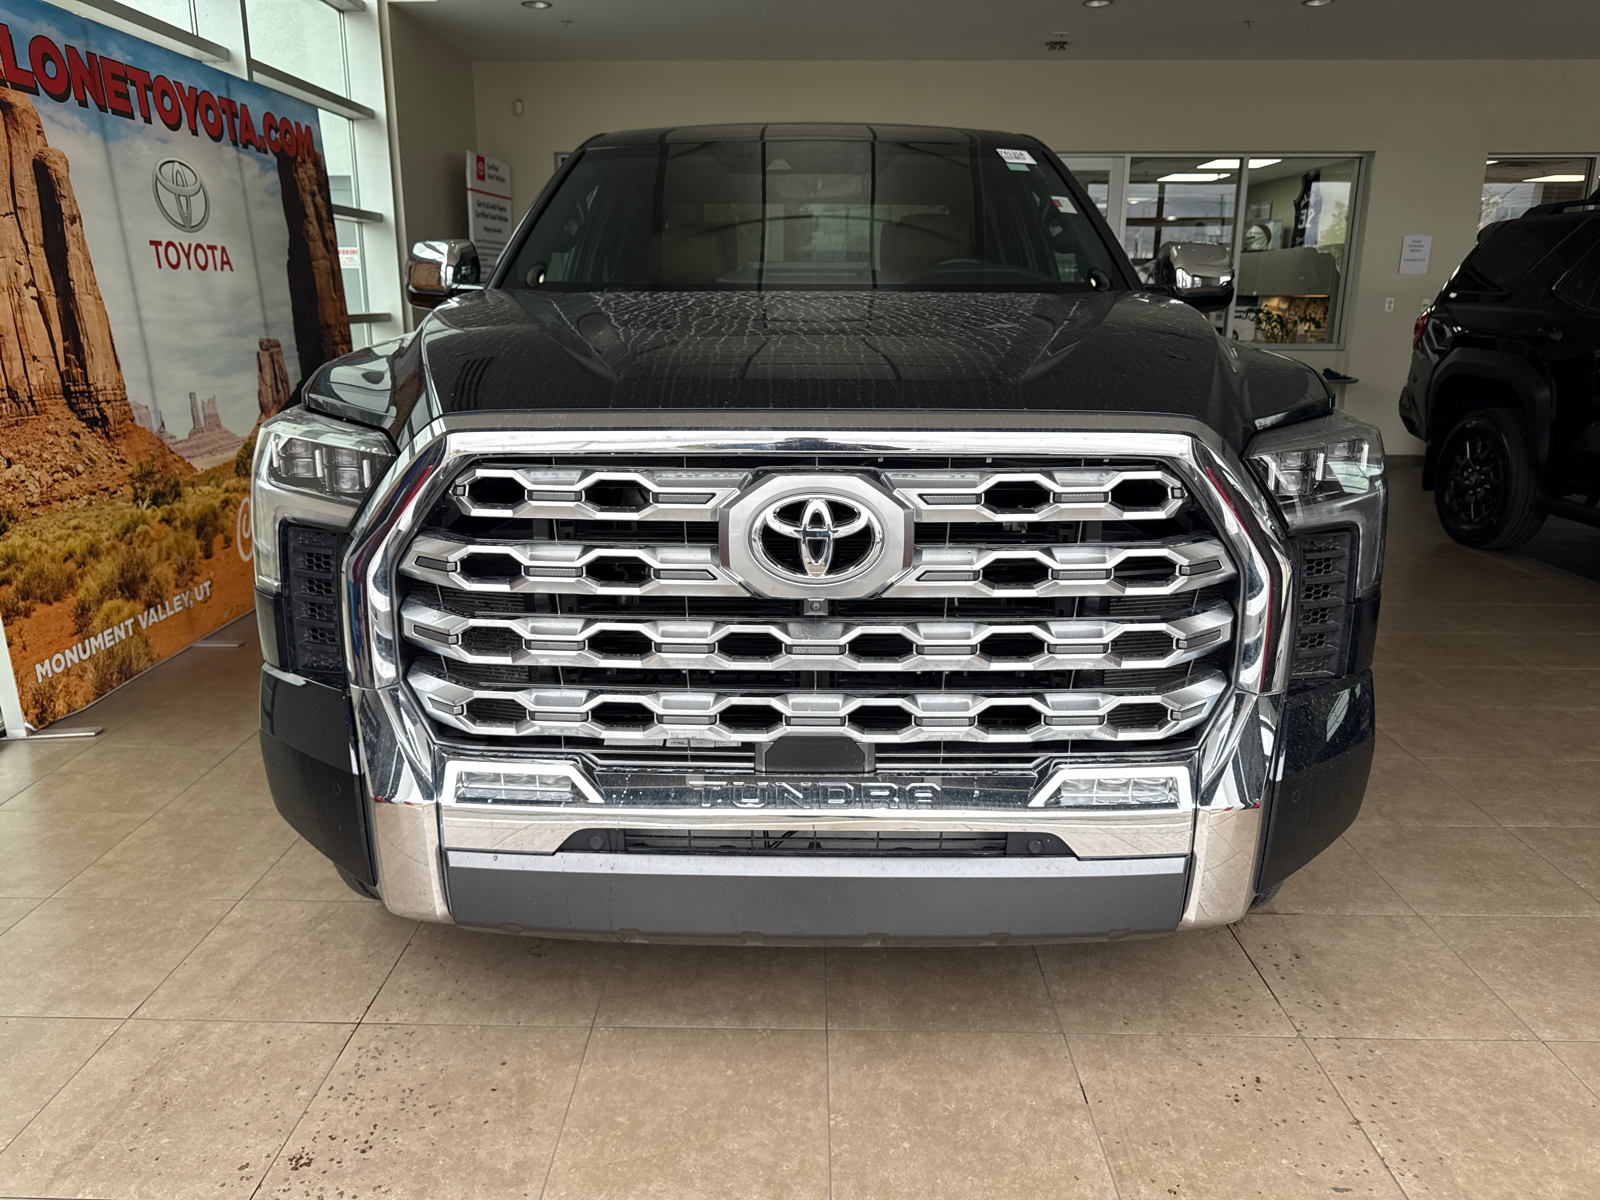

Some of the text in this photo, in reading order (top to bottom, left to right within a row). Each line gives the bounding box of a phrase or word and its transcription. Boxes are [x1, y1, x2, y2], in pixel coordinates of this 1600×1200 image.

[0, 23, 316, 161] LONETOYOTA.COM
[1298, 208, 1315, 229] 32
[149, 240, 234, 272] TOYOTA
[34, 580, 212, 684] MONUMENT VALLEY, UT
[688, 781, 942, 809] TUNDRA
